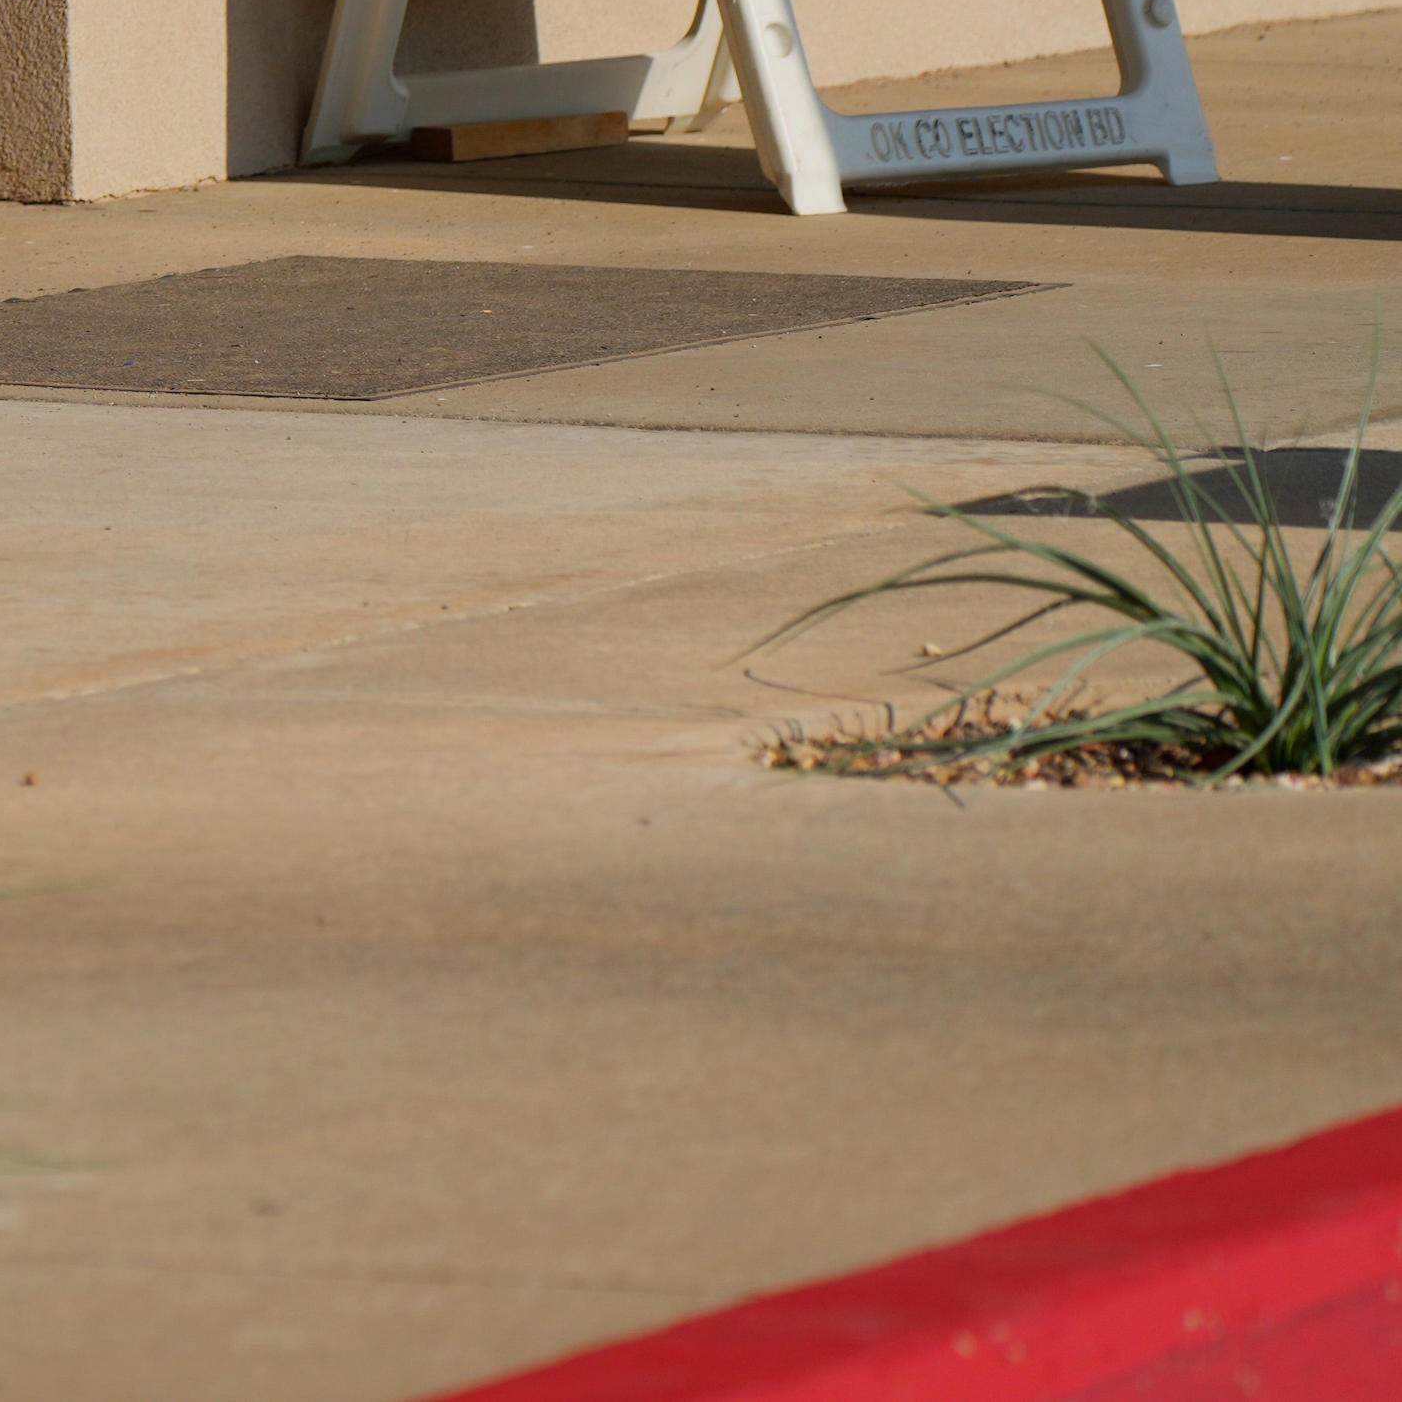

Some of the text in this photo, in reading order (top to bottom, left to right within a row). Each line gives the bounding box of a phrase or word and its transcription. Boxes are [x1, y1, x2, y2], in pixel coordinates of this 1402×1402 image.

[870, 107, 1126, 162] OK CO ELECTION BD
